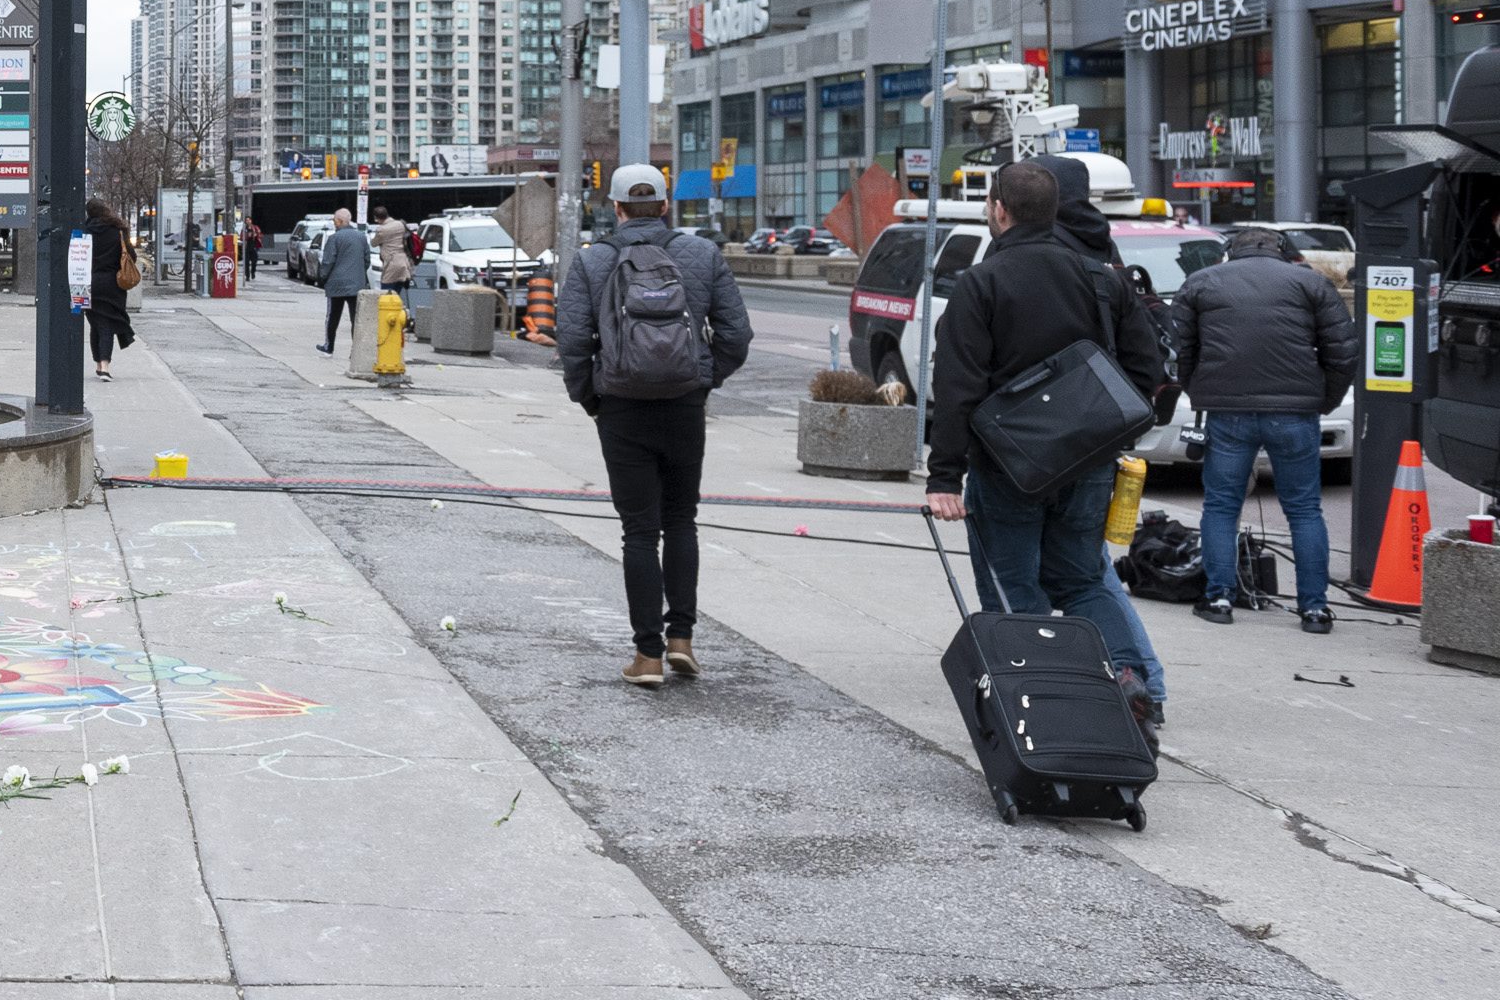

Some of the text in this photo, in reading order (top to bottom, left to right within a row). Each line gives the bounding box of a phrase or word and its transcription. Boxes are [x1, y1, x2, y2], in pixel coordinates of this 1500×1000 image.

[1141, 20, 1232, 51] CINEMAS
[1160, 122, 1206, 160] Empress
[1230, 116, 1262, 156] Walk
[1373, 276, 1408, 287] 7407
[857, 295, 888, 312] BREAKING
[1411, 516, 1420, 572] ROGERS
